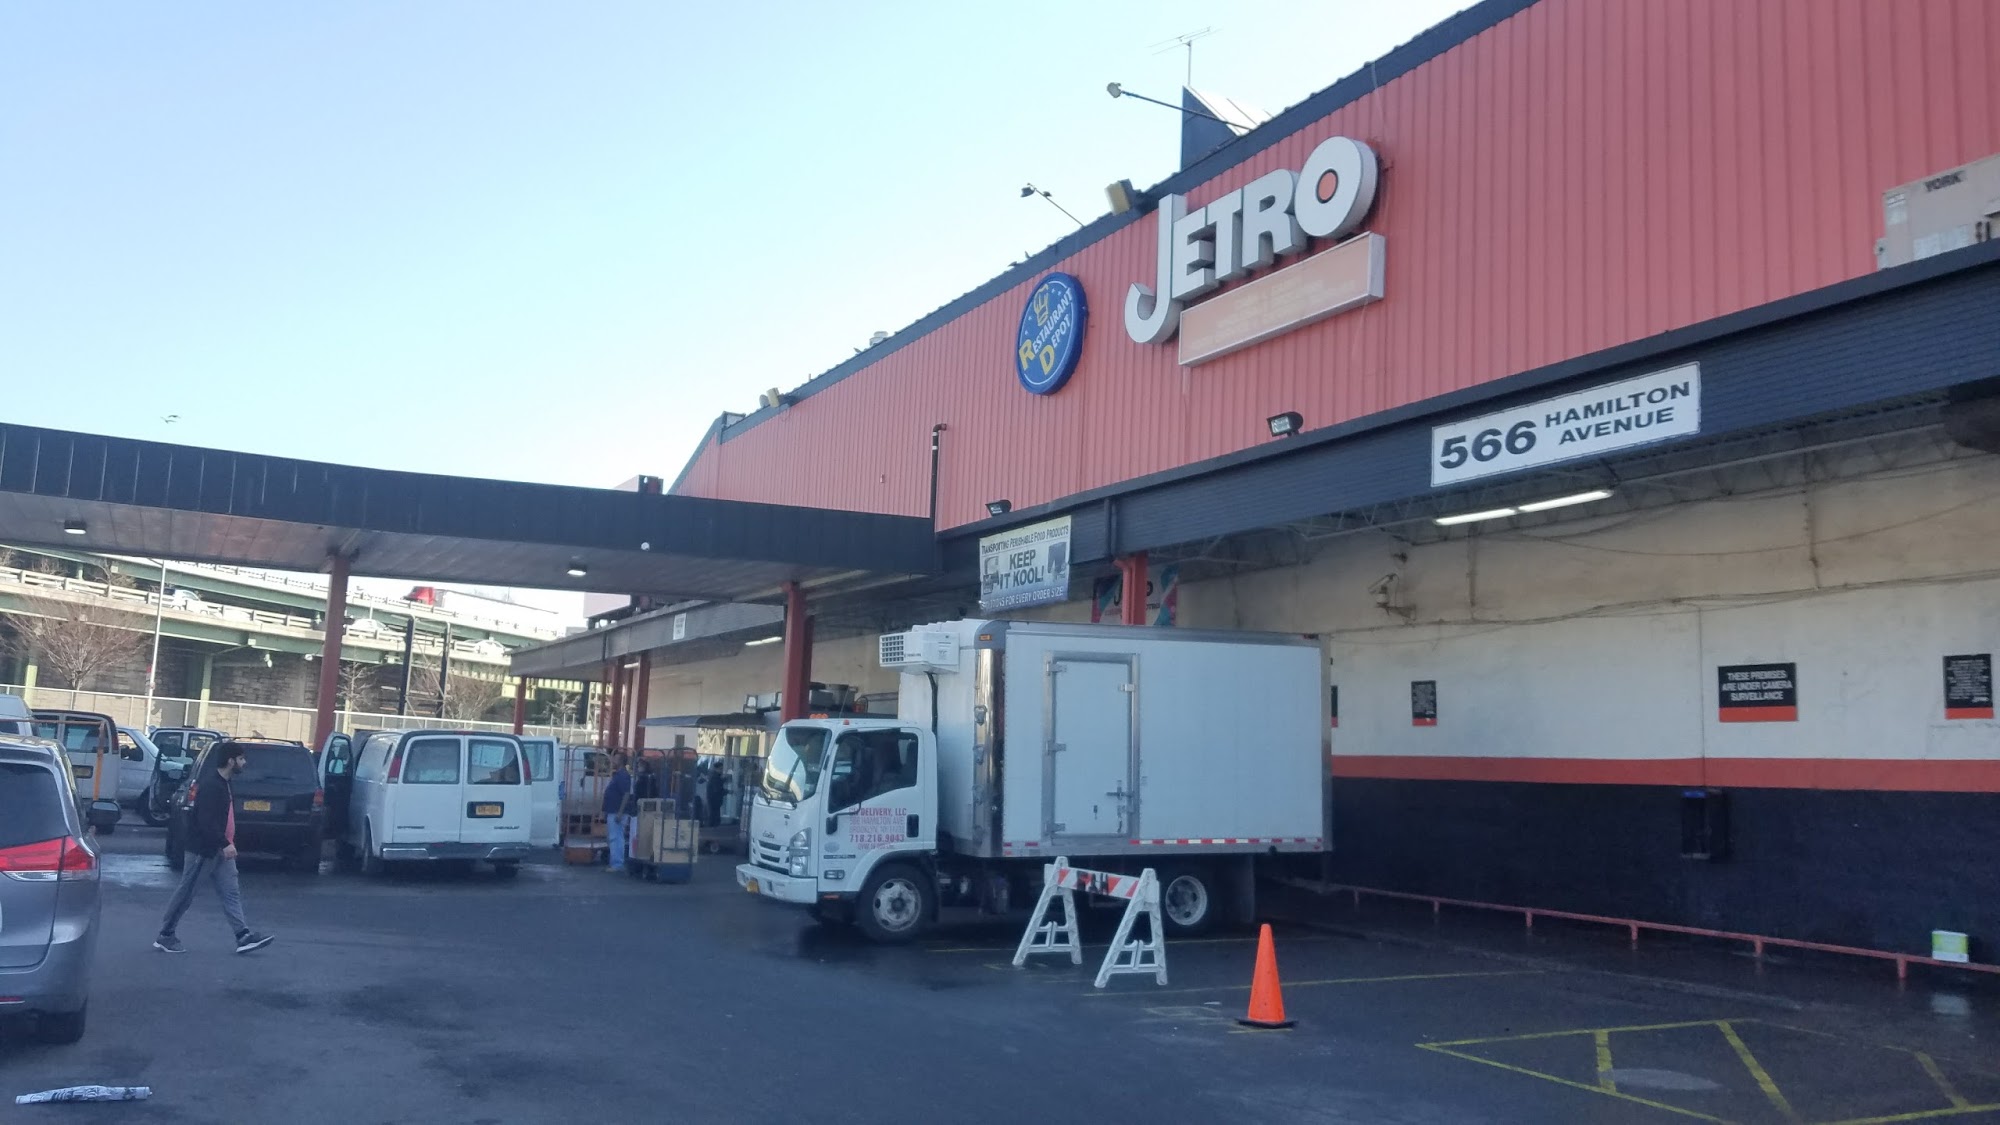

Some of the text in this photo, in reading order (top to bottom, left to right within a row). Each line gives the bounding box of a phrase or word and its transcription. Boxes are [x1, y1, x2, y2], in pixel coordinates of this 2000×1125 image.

[1925, 170, 1966, 192] YORK
[1124, 136, 1374, 343] JETRO
[1019, 287, 1073, 371] RESTAURANT
[1040, 314, 1071, 375] DEPOT
[1545, 382, 1690, 428] HAMILTON
[1559, 407, 1675, 445] AVENUE
[1439, 420, 1537, 469] 566
[1009, 533, 1034, 548] PERISHABLE
[1034, 530, 1046, 542] FOOD
[1046, 525, 1069, 540] PRODUCTS
[1009, 549, 1036, 570] KEEP
[1000, 573, 1011, 589] IT
[1012, 565, 1045, 588] KOOL!
[1015, 591, 1032, 604] EVERY
[1032, 588, 1050, 601] ORDER
[1722, 680, 1793, 691] ARE UNDER CAMERA
[1727, 669, 1787, 681] THESE PREMISES
[1730, 691, 1784, 701] SURVEILLANCE
[860, 807, 893, 816] DELIVERY,
[895, 807, 907, 815] LLC
[849, 834, 905, 843] 718.216.9043
